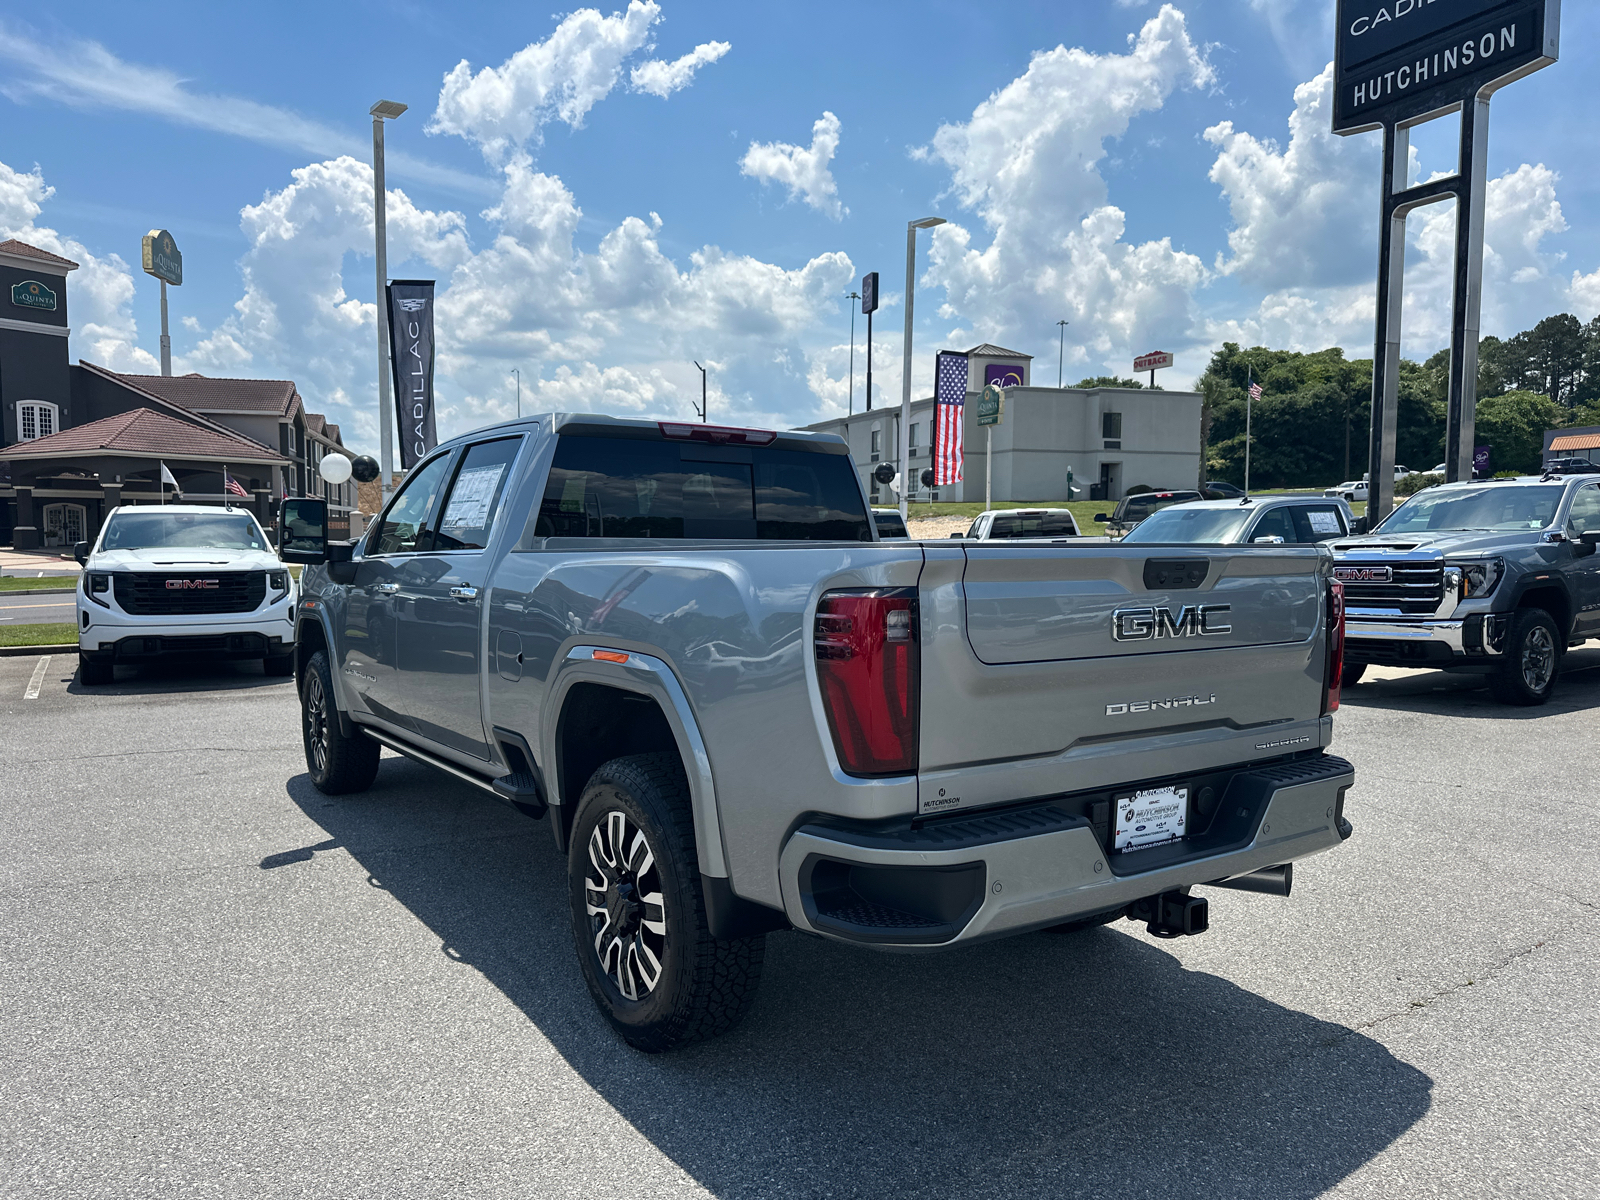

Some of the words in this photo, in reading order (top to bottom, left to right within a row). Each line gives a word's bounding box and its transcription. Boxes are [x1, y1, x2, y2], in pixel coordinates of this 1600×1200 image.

[1353, 24, 1516, 107] HUTCHINSON
[159, 253, 181, 275] QUINTA
[22, 293, 54, 304] QUINTA
[1133, 355, 1168, 369] OUTBACK
[409, 321, 426, 458] CADILLAC
[1335, 568, 1390, 581] GMC
[165, 579, 220, 589] GMC
[1111, 603, 1232, 642] GMC
[1105, 693, 1216, 716] DENALI
[1255, 735, 1310, 750] SIERRA
[923, 797, 961, 808] HUTCHINSON
[1135, 803, 1180, 819] HUTCHINSON
[1135, 814, 1163, 824] AUTOMOTIVE
